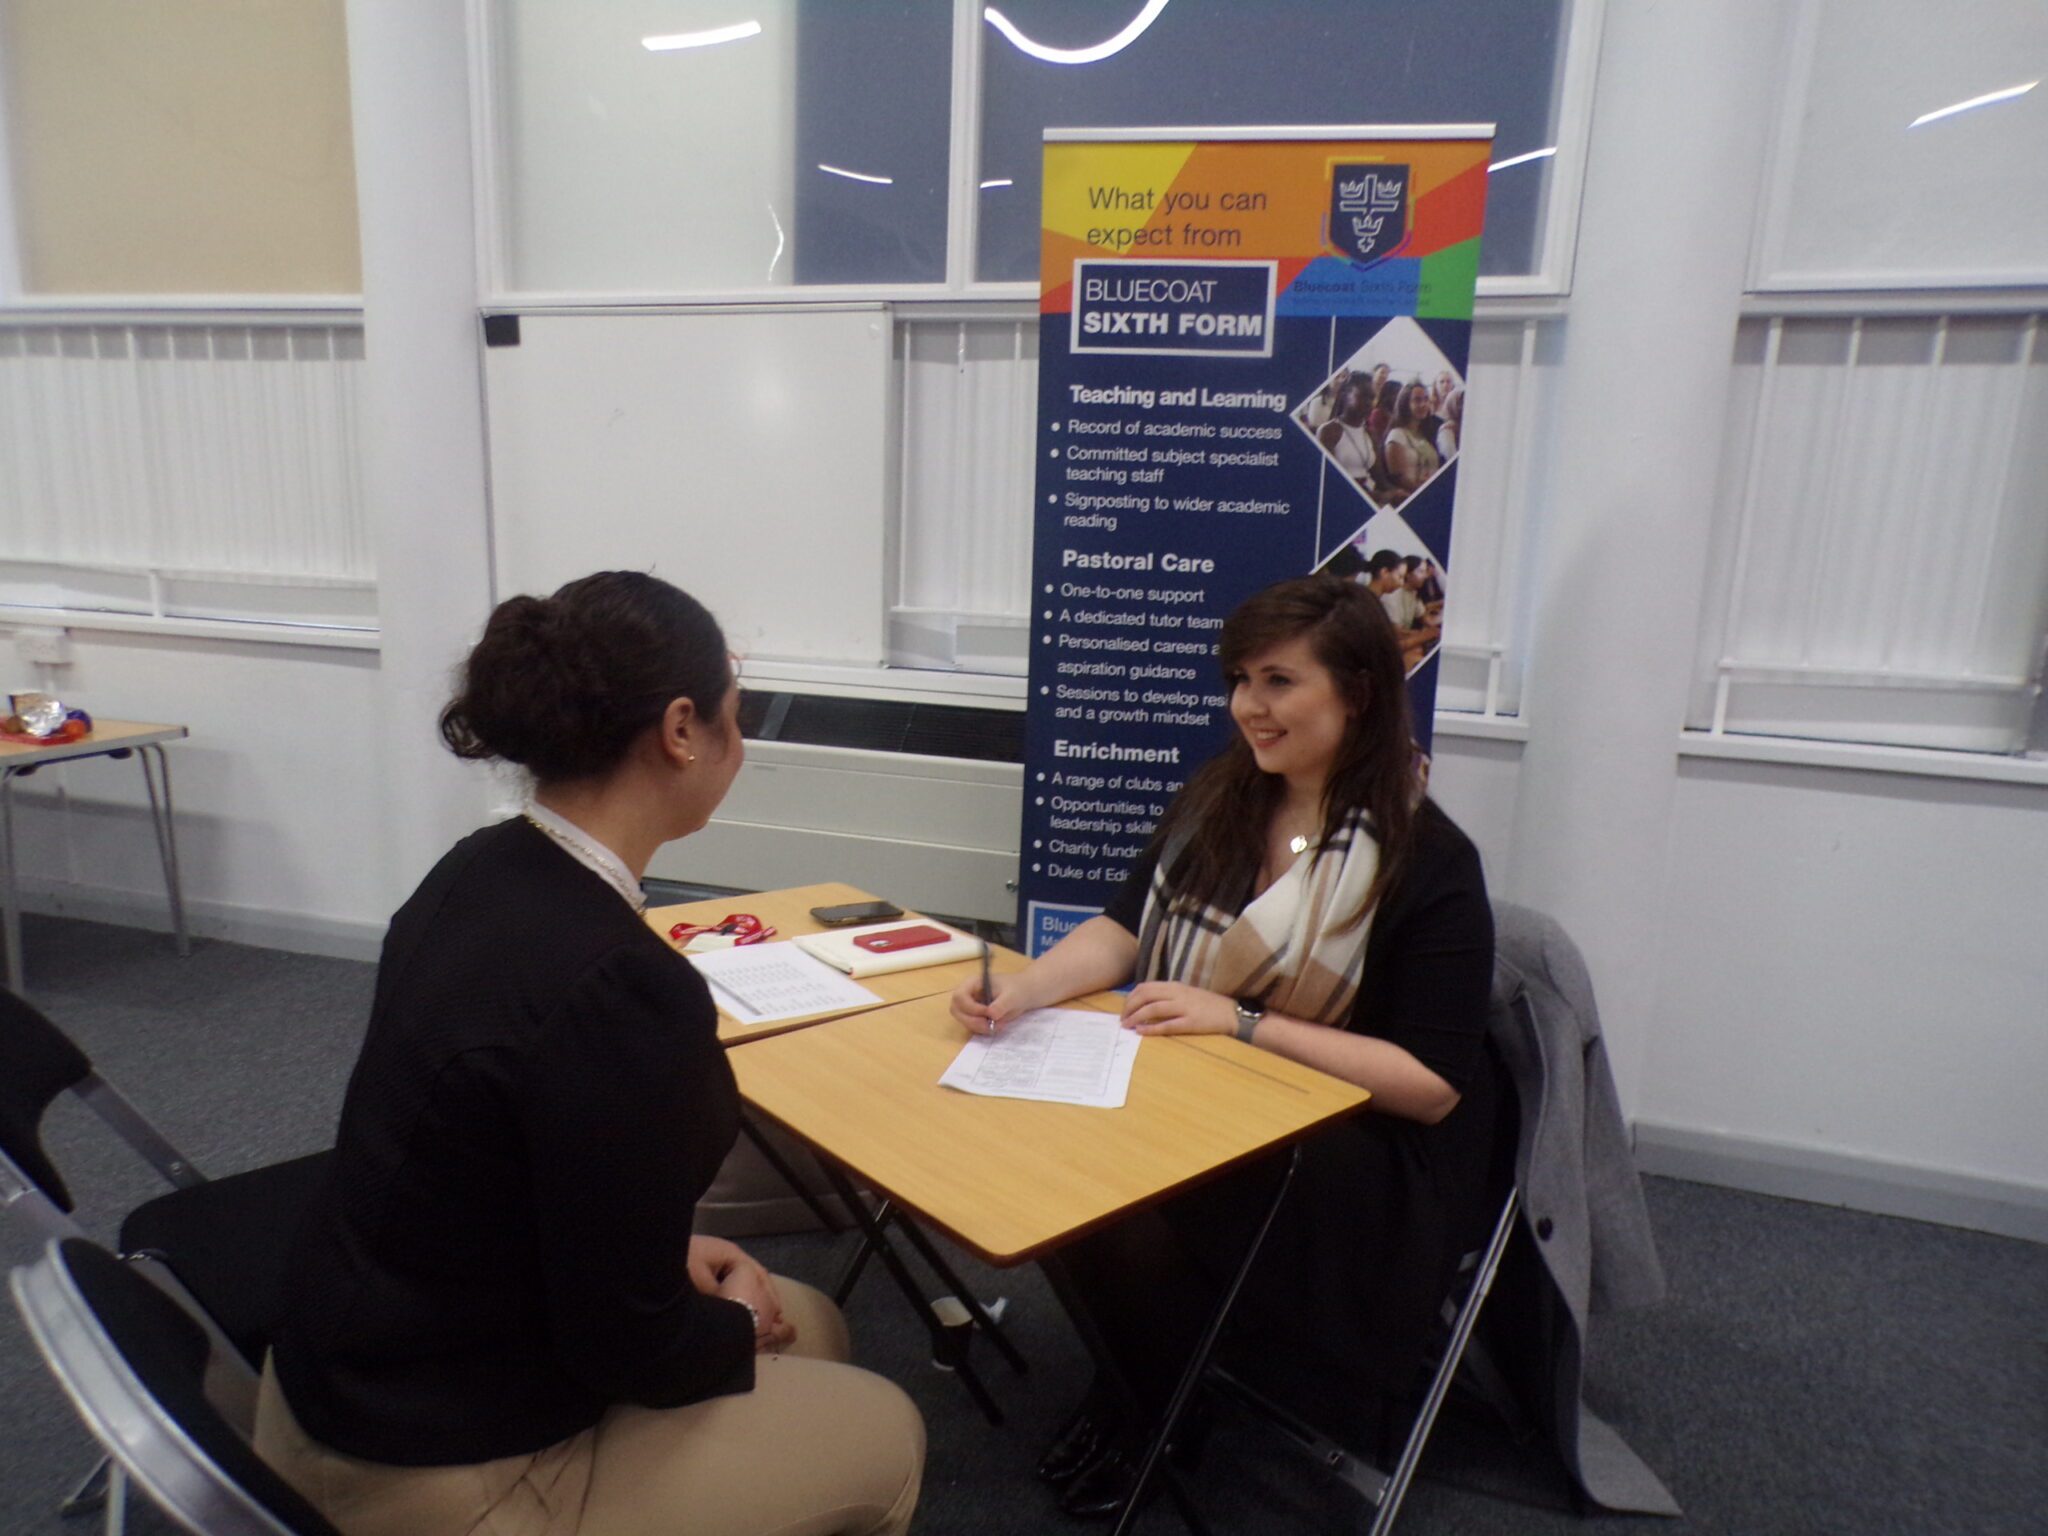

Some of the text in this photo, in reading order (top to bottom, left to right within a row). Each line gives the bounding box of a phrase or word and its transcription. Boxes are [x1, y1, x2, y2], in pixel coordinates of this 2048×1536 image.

[1088, 186, 1267, 216] What you can
[1087, 224, 1241, 250] expect from
[1085, 279, 1217, 304] BLUECOAT
[1083, 311, 1262, 337] SIXTH FORM
[1069, 385, 1287, 412] Teaching and Learning
[1068, 419, 1282, 439] Record of academic success
[1066, 446, 1279, 467] Committed subject specialist
[1066, 467, 1164, 485] teaching staff
[1064, 492, 1291, 514] Signposting to wider academic
[1064, 514, 1117, 532] reading
[1062, 550, 1215, 573] Pastoral Care
[1060, 583, 1205, 604] One-to-one support
[1059, 610, 1224, 629] A dedicated tutor team
[1058, 634, 1149, 652] Personalised
[1153, 641, 1208, 655] careers
[1057, 660, 1196, 680] aspiration guidance
[1056, 685, 1120, 702] Sessions
[1124, 689, 1138, 702] to
[1142, 690, 1199, 708] develop
[1055, 706, 1210, 726] and a growth mindset
[1054, 739, 1180, 763] Enrichment
[1052, 772, 1063, 784] A
[1065, 776, 1104, 791] range
[1108, 776, 1123, 789] of
[1125, 777, 1162, 791] clubs
[1051, 796, 1164, 816] Opportunities to
[1050, 815, 1121, 835] leadership
[1049, 839, 1098, 859] Charity
[1048, 864, 1083, 880] Duke
[1087, 868, 1102, 880] of
